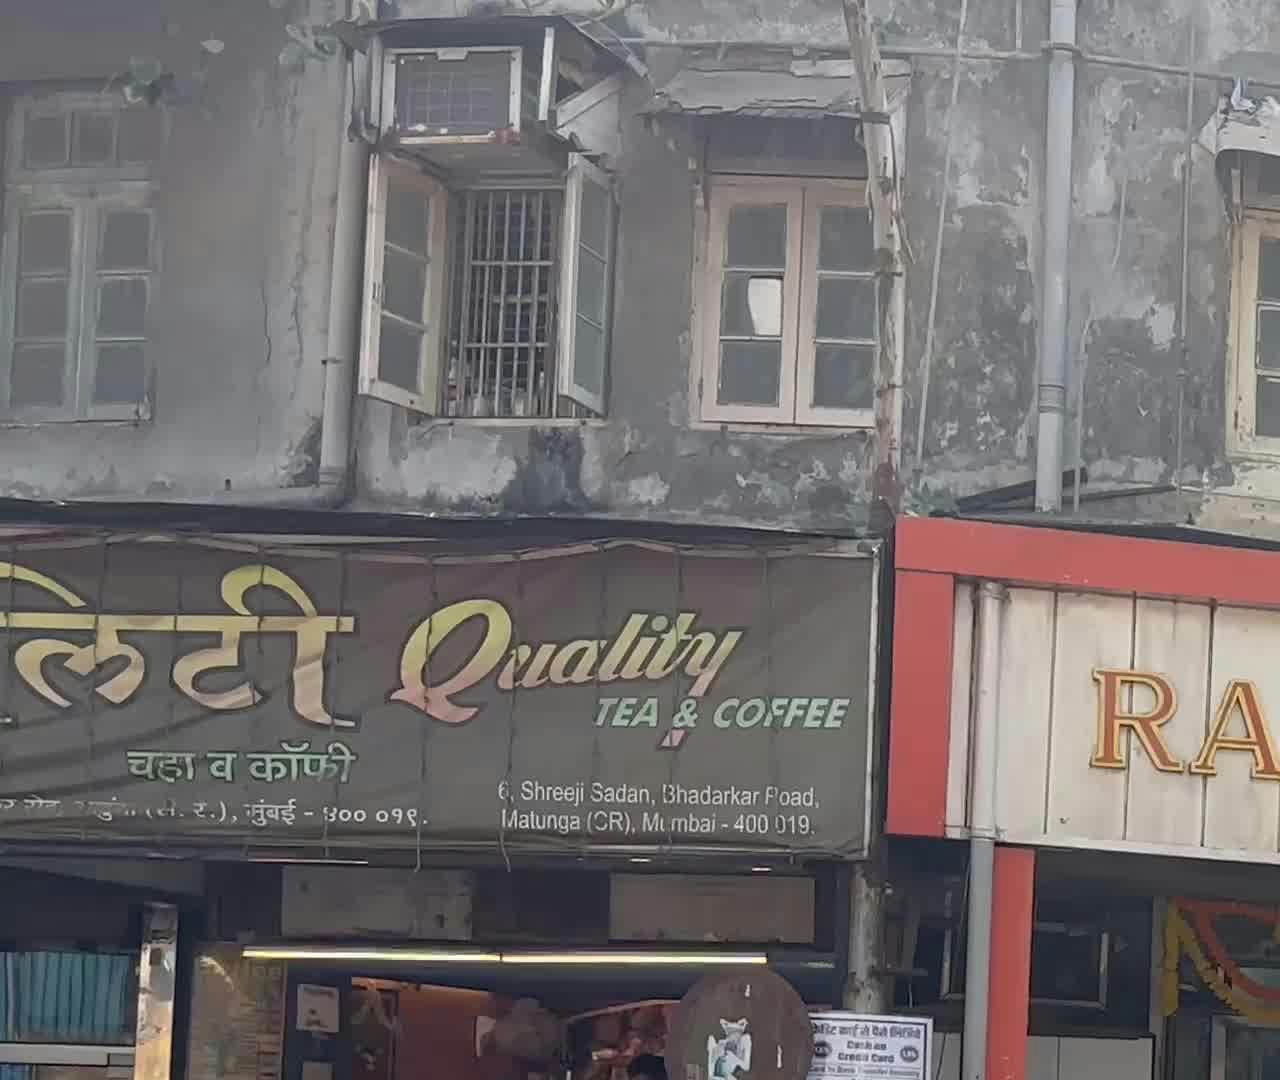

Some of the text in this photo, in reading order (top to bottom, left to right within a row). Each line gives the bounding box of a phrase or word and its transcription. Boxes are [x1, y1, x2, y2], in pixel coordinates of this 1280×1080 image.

[390, 599, 744, 748] Quality
[597, 697, 850, 729] TEA & COFFEE
[206, 752, 238, 781] व
[246, 741, 356, 783] कॉफी
[520, 780, 584, 806] Shreeji
[590, 782, 655, 806] Sadan,
[662, 783, 760, 806] Bhadarkar
[501, 808, 581, 834] Matunga
[587, 810, 636, 835] (CR),
[642, 812, 716, 833] Mumbai
[733, 813, 768, 834] 400
